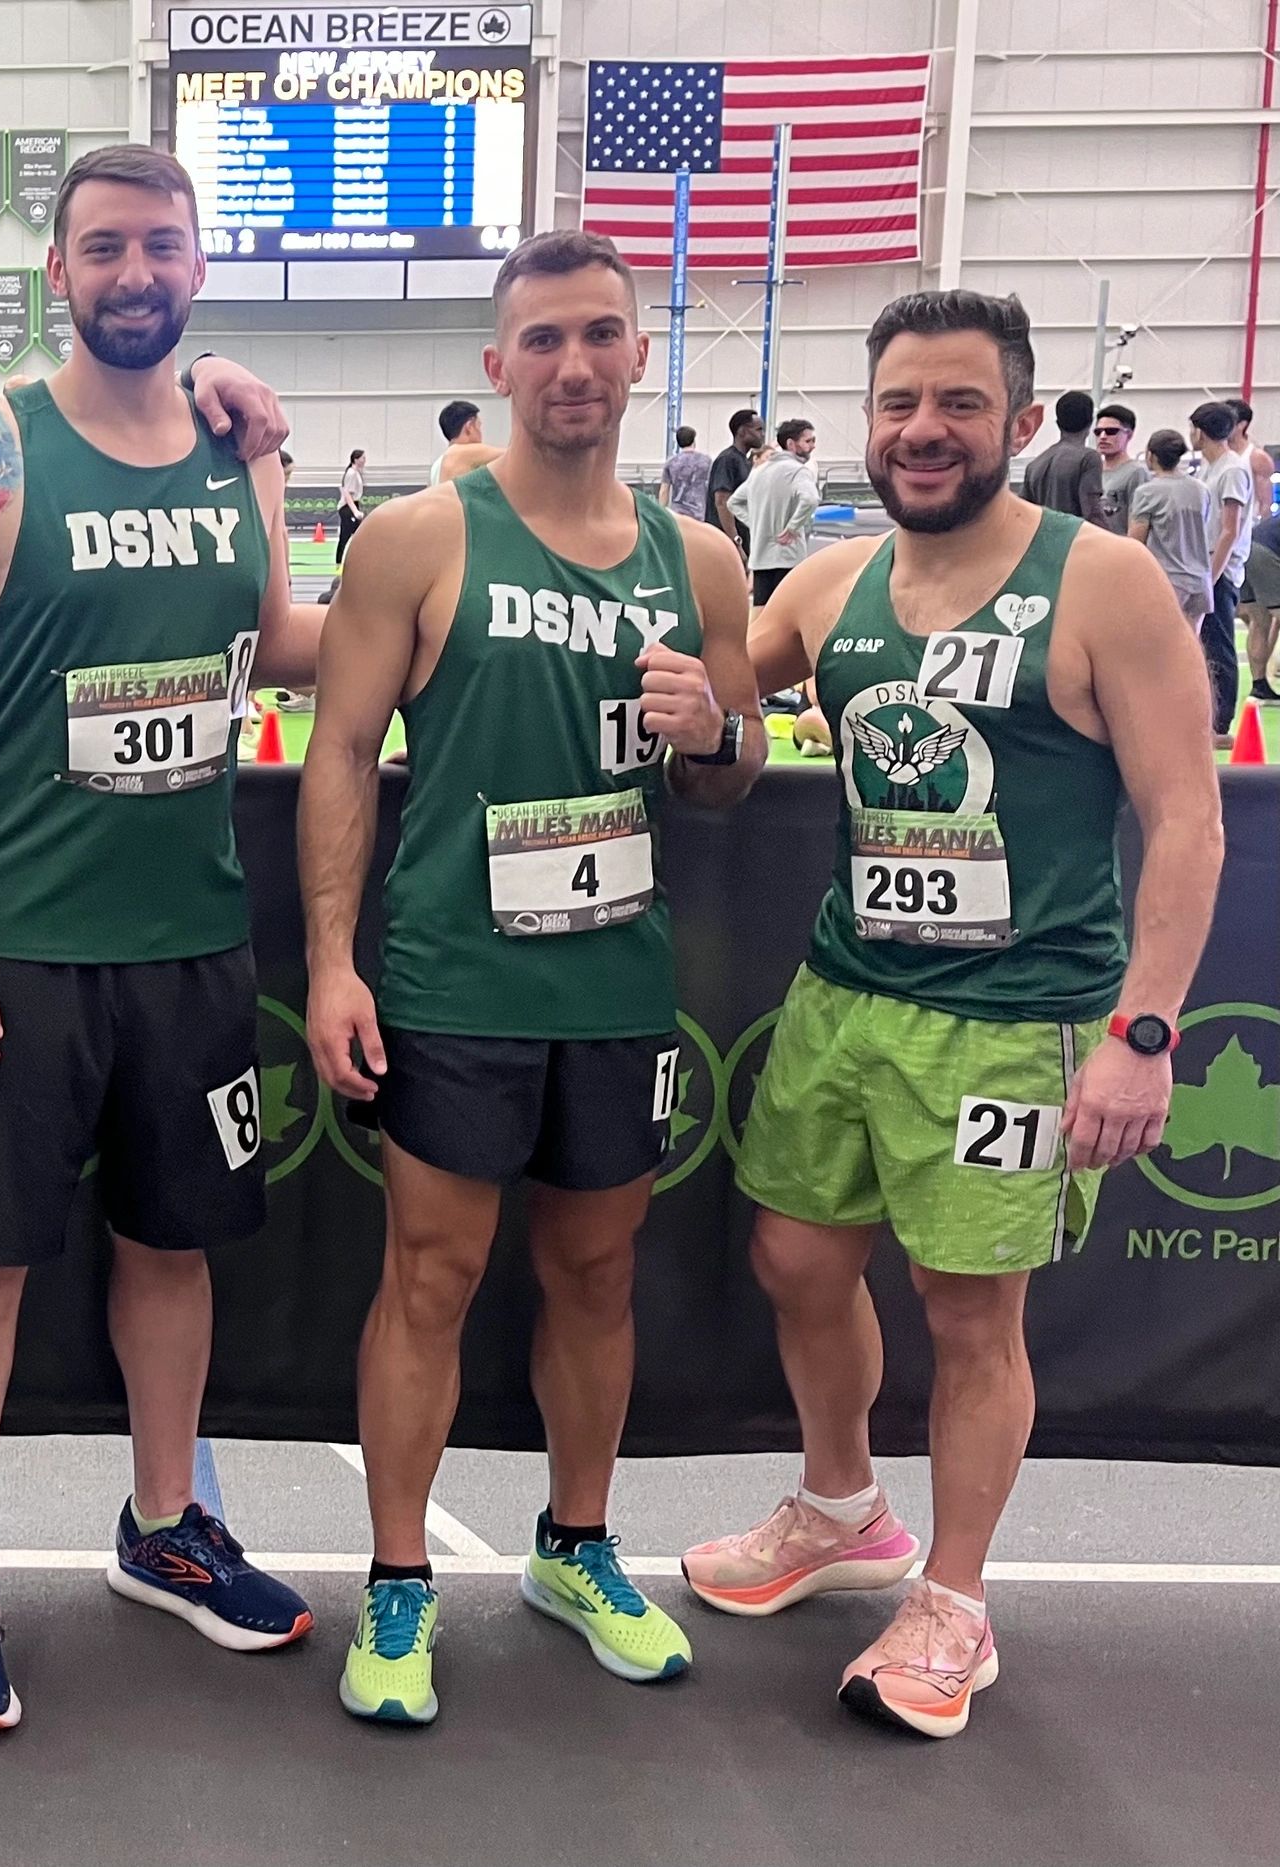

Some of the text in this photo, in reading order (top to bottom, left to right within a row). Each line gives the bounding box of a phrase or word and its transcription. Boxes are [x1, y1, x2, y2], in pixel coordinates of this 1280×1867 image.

[190, 11, 471, 45] OCEAN BREEZE
[280, 50, 437, 75] NEW JERSEY
[176, 69, 525, 101] MEET OF CHAMPIONS
[15, 137, 61, 146] AMERICAN
[20, 145, 56, 154] RECORD
[65, 507, 240, 571] DSNY
[488, 582, 679, 658] DSNY
[833, 638, 885, 653] GO SAP
[72, 670, 225, 702] MILES MANIA
[76, 666, 145, 680] OCEAN BREEZE
[231, 637, 252, 714] 8
[924, 635, 1000, 703] 21
[876, 683, 926, 708] DSN
[114, 714, 193, 765] 301
[606, 702, 660, 764] 19
[494, 803, 645, 841] MILES MANIA
[496, 802, 569, 818] OCEAN BREEZE
[903, 827, 998, 850] MANIA
[571, 853, 599, 897] 4
[866, 865, 958, 915] 293
[227, 1080, 258, 1153] 8
[963, 1103, 1040, 1169] 21
[1127, 1228, 1280, 1261] NYC Par
